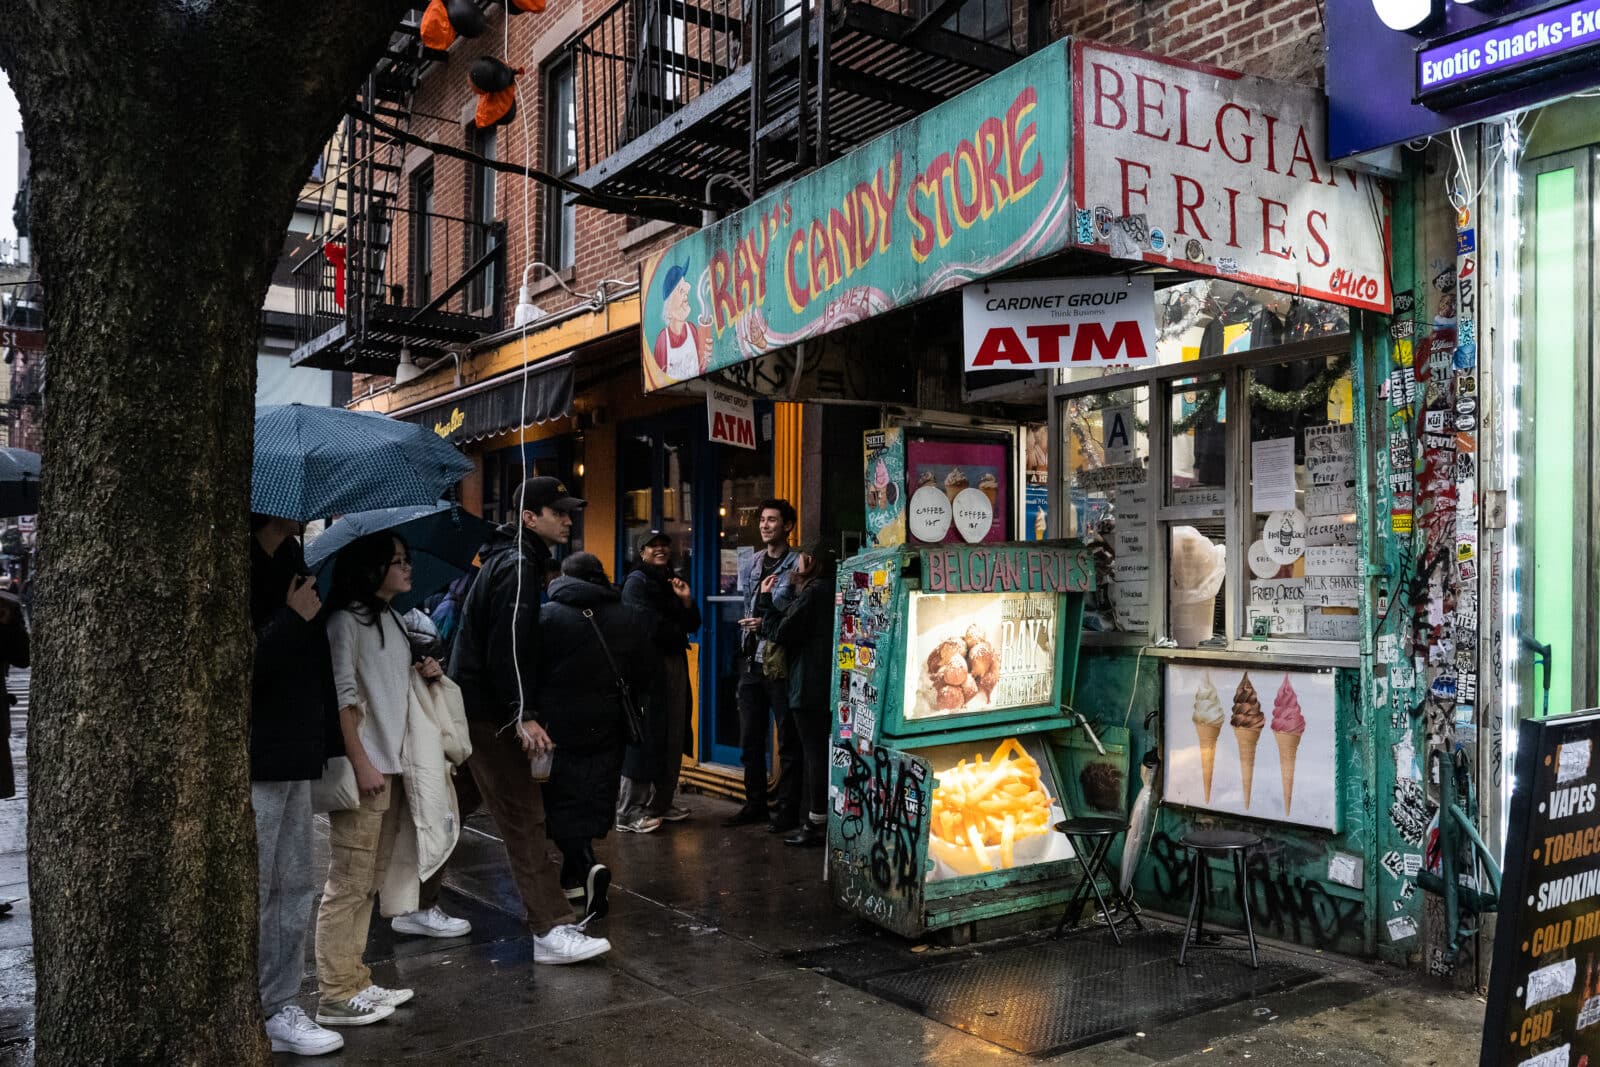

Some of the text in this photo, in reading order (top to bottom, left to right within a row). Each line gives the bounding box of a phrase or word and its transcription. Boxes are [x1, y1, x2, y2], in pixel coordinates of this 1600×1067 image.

[1423, 48, 1481, 85] Exotic
[709, 86, 1044, 339] RAY'S CANDY STORE
[1114, 157, 1330, 268] FRIES
[986, 291, 1128, 312] CARDNET GROUP
[1329, 267, 1379, 301] CHICO
[1051, 308, 1106, 318] Think Business
[2, 332, 17, 346] St
[971, 320, 1148, 367] ATM
[712, 411, 755, 447] ATM
[1107, 412, 1129, 449] A
[929, 551, 1091, 593] BELGIAN FRIES
[1456, 669, 1468, 704] 2MUCH
[1465, 673, 1477, 701] BLAH
[1549, 783, 1597, 820] VAPES
[1531, 919, 1572, 958] COLD
[1520, 1010, 1553, 1047] CBD
